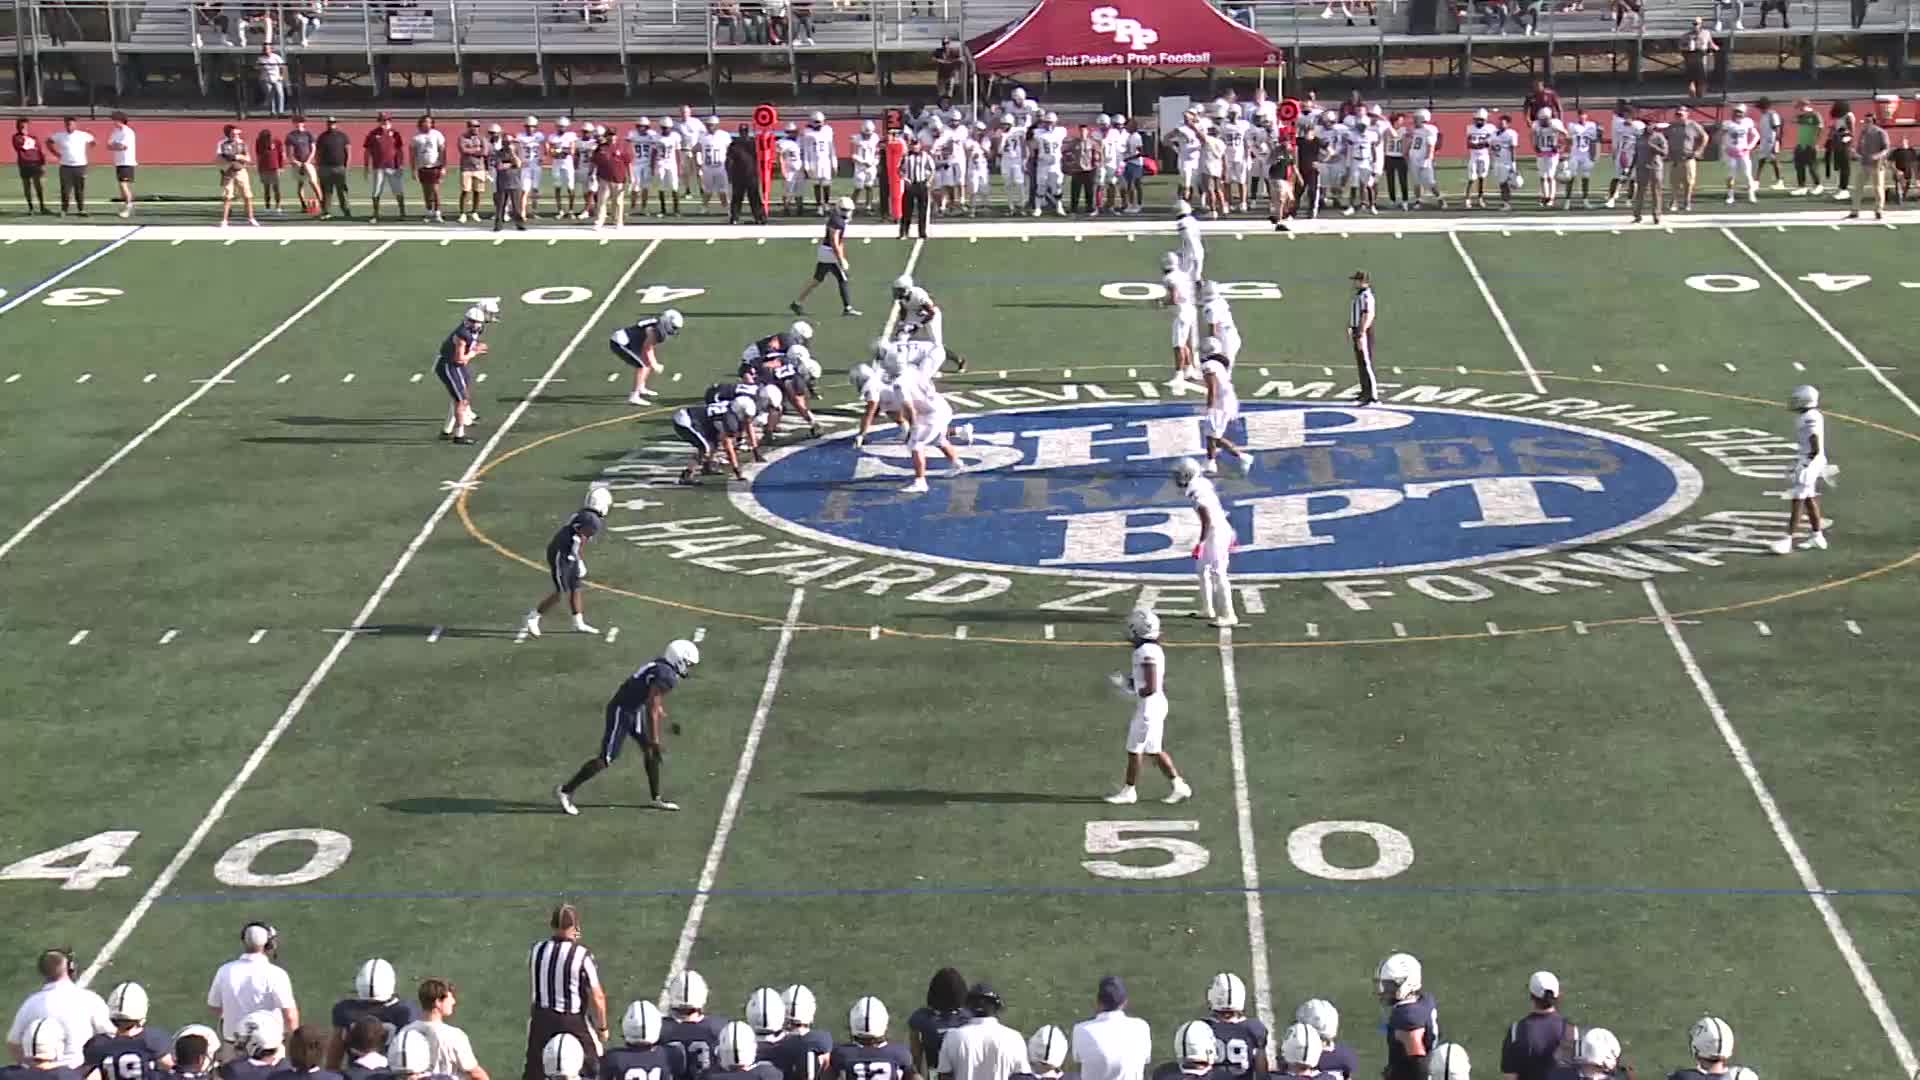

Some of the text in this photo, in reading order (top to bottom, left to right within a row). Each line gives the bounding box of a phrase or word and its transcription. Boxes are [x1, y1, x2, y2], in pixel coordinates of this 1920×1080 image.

[1046, 51, 1211, 66] Saint Peter's Prep Football
[852, 406, 1415, 480] SHP
[1252, 380, 1712, 432] MEMORIAL
[1039, 475, 1606, 566] BPT
[607, 510, 1834, 617] HAZARD ZET FORWARD
